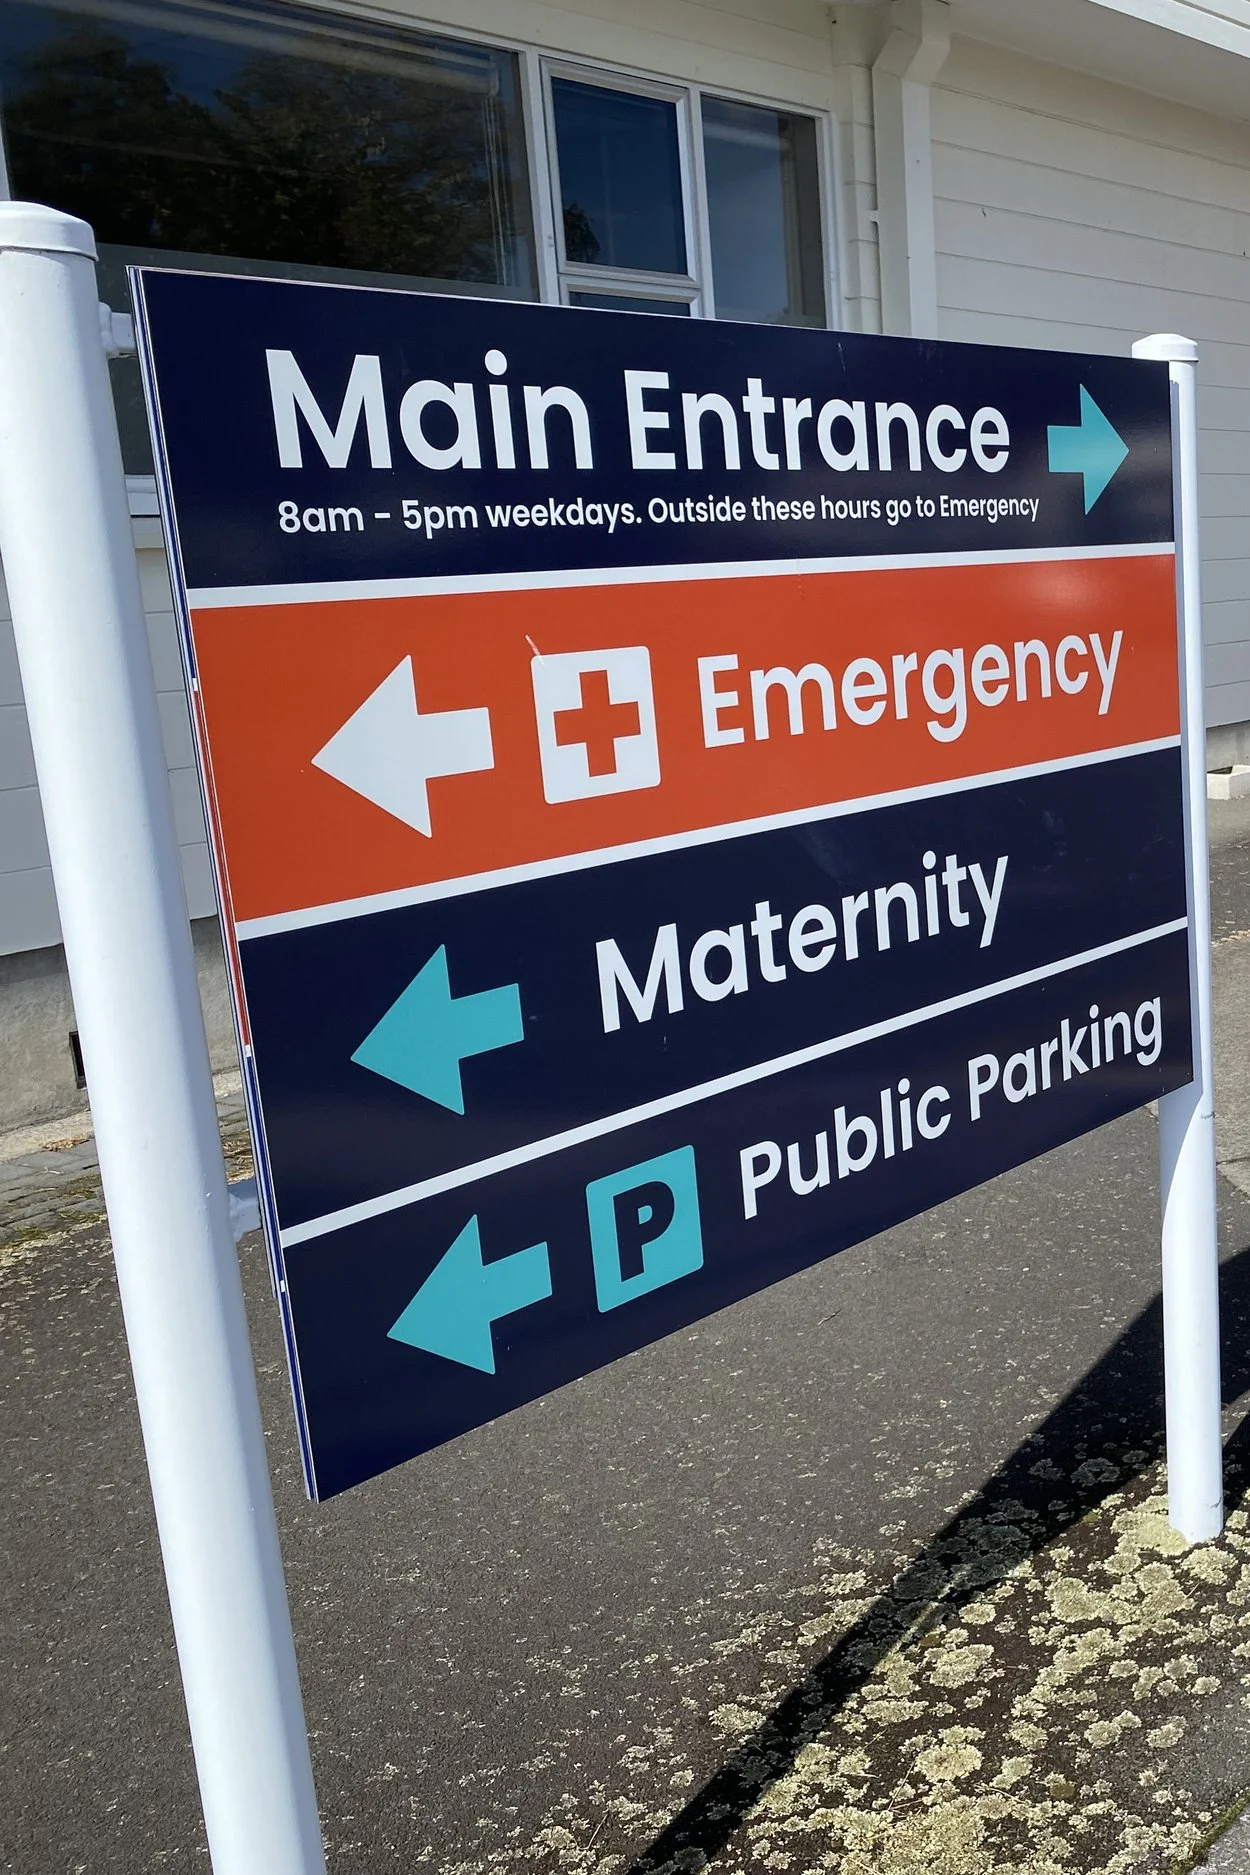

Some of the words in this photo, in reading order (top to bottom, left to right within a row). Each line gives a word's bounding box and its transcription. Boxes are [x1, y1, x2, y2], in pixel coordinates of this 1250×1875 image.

[266, 349, 594, 471] Main
[624, 369, 1010, 473] Entrance
[278, 500, 365, 534] 8am
[401, 499, 479, 540] 5pm
[484, 497, 643, 534] weekdays.
[647, 495, 747, 525] Outside
[750, 495, 816, 522] these
[820, 494, 882, 520] hours
[885, 499, 912, 526] go
[915, 495, 936, 519] to
[939, 494, 1040, 525] Emergency
[697, 630, 1124, 749] Emergency
[595, 850, 1009, 1035] Maternity
[739, 1077, 952, 1220] Public
[967, 997, 1162, 1121] Parking
[613, 1180, 675, 1282] P
